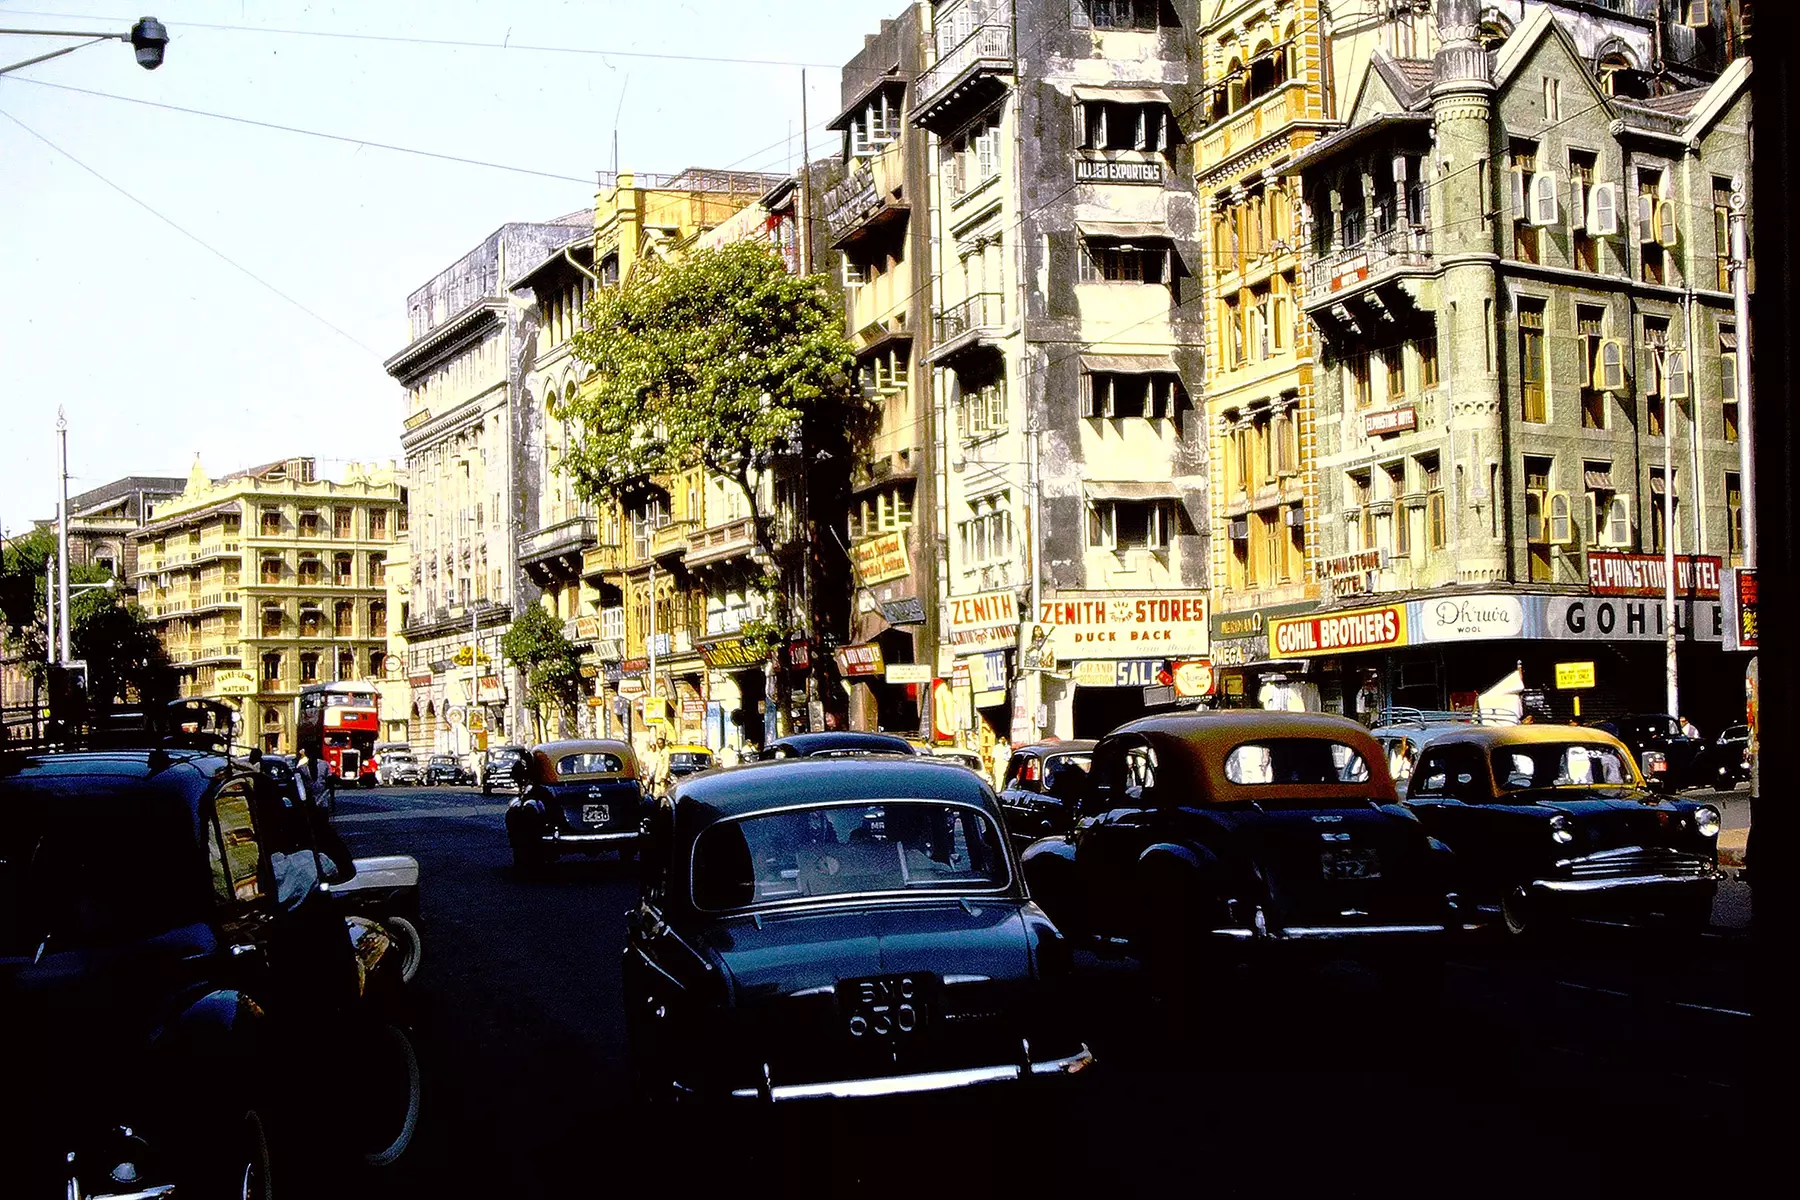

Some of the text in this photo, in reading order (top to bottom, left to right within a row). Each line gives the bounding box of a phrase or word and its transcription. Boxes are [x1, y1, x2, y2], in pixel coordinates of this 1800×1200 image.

[1078, 161, 1160, 180] ALLIED EXPORTERS
[1332, 574, 1365, 595] HOTEL
[1589, 558, 1720, 590] ELPHINSTON HOTEL
[951, 594, 1012, 625] ZENITH
[1040, 599, 1203, 625] ZENITH STORES
[1566, 602, 1690, 635] GOHIL
[1075, 630, 1172, 642] DUCK BACK
[1278, 611, 1396, 652] GOHIL BROTHERS
[1079, 662, 1114, 673] GRAND
[1210, 646, 1246, 666] OMEGA
[1117, 661, 1163, 686] SALE
